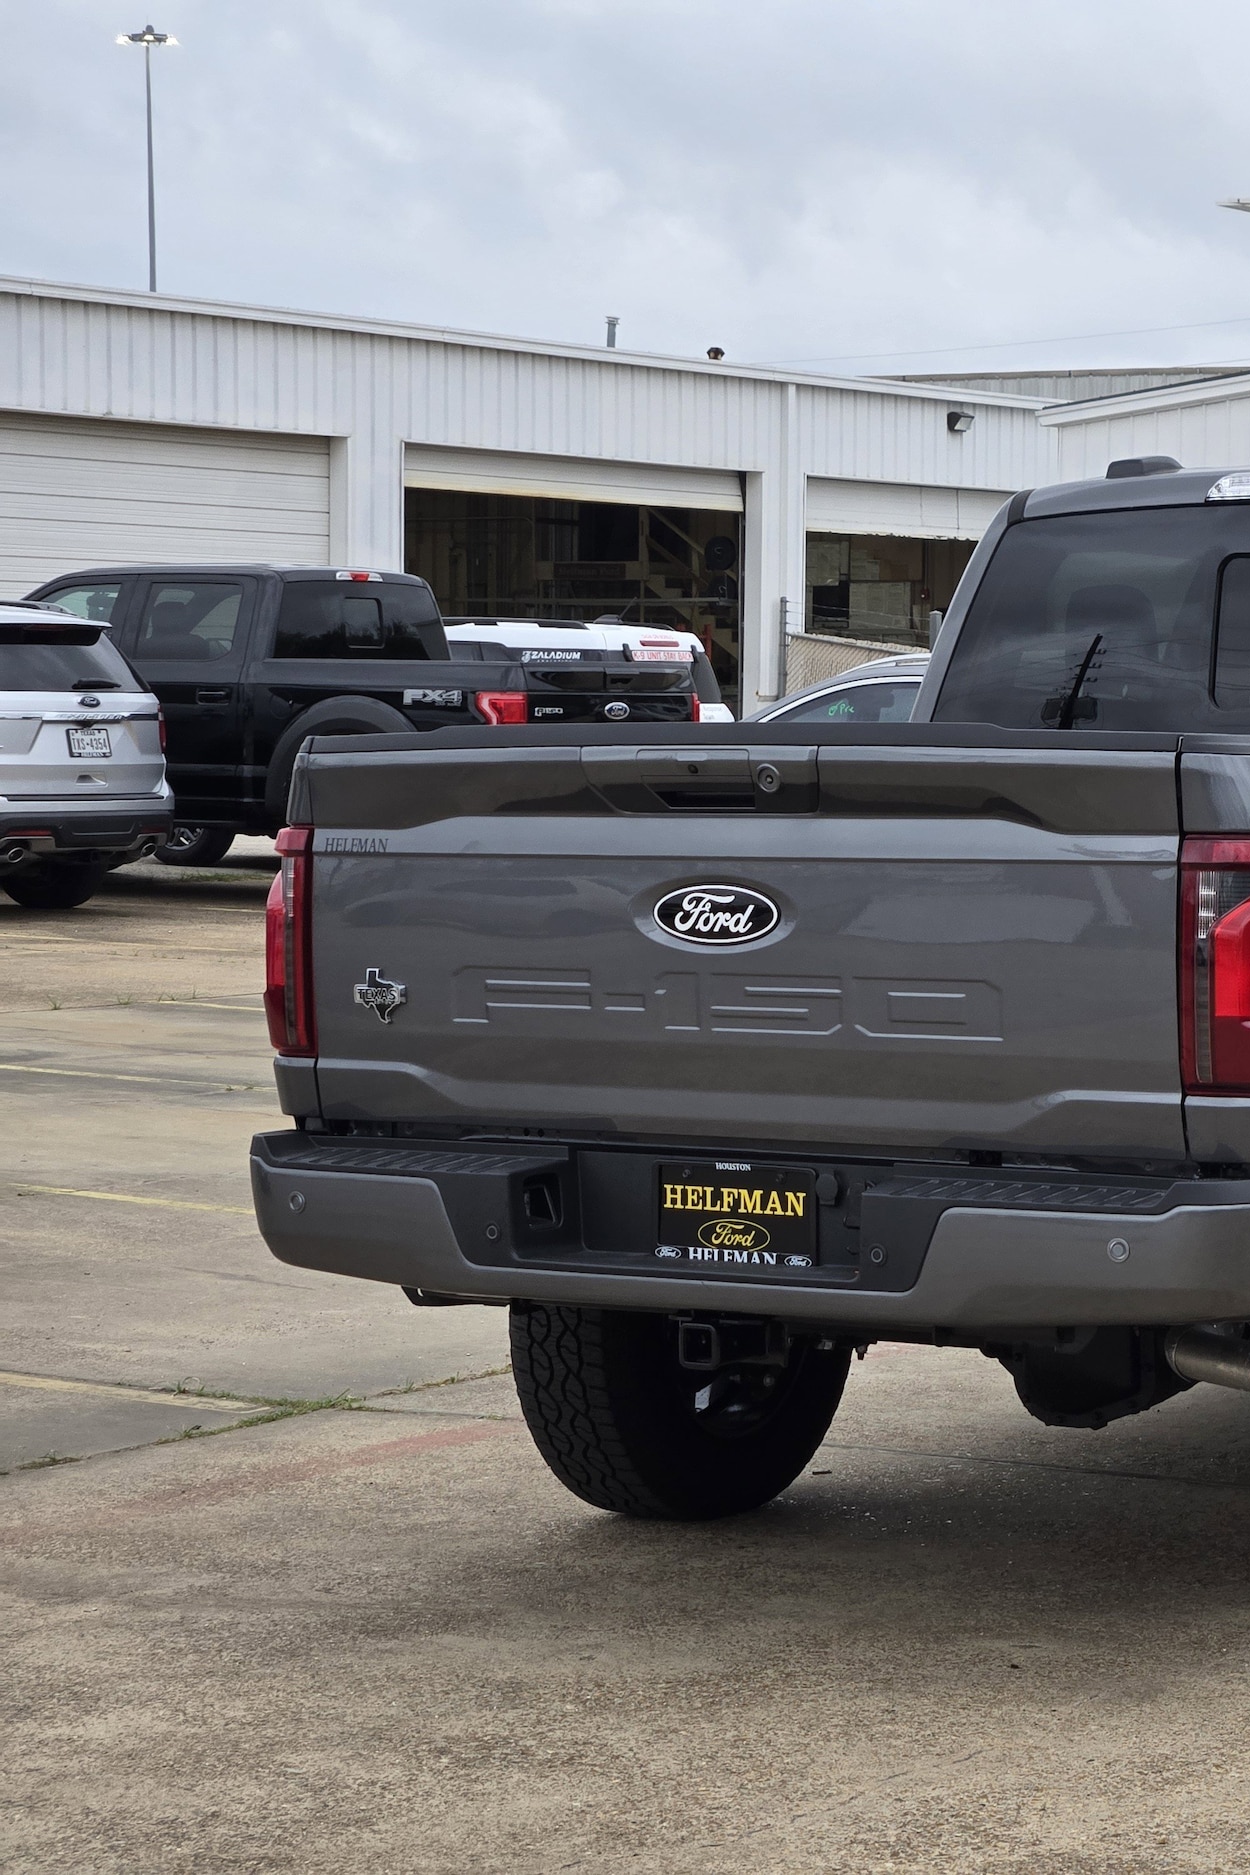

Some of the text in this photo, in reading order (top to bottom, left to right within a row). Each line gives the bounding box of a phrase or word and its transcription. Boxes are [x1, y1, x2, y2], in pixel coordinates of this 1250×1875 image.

[531, 651, 581, 660] ZALADIUM
[647, 651, 661, 661] UNIT
[663, 651, 677, 661] STAY
[678, 651, 692, 661] BACK
[402, 688, 463, 706] FX4
[324, 837, 389, 853] HELFMAN
[674, 892, 755, 933] Ford
[355, 987, 400, 1002] TEXAS
[451, 965, 1004, 1042] F-150
[715, 1162, 752, 1172] HOUSTON
[663, 1183, 807, 1217] HELFMAN
[711, 1222, 756, 1247] Ford
